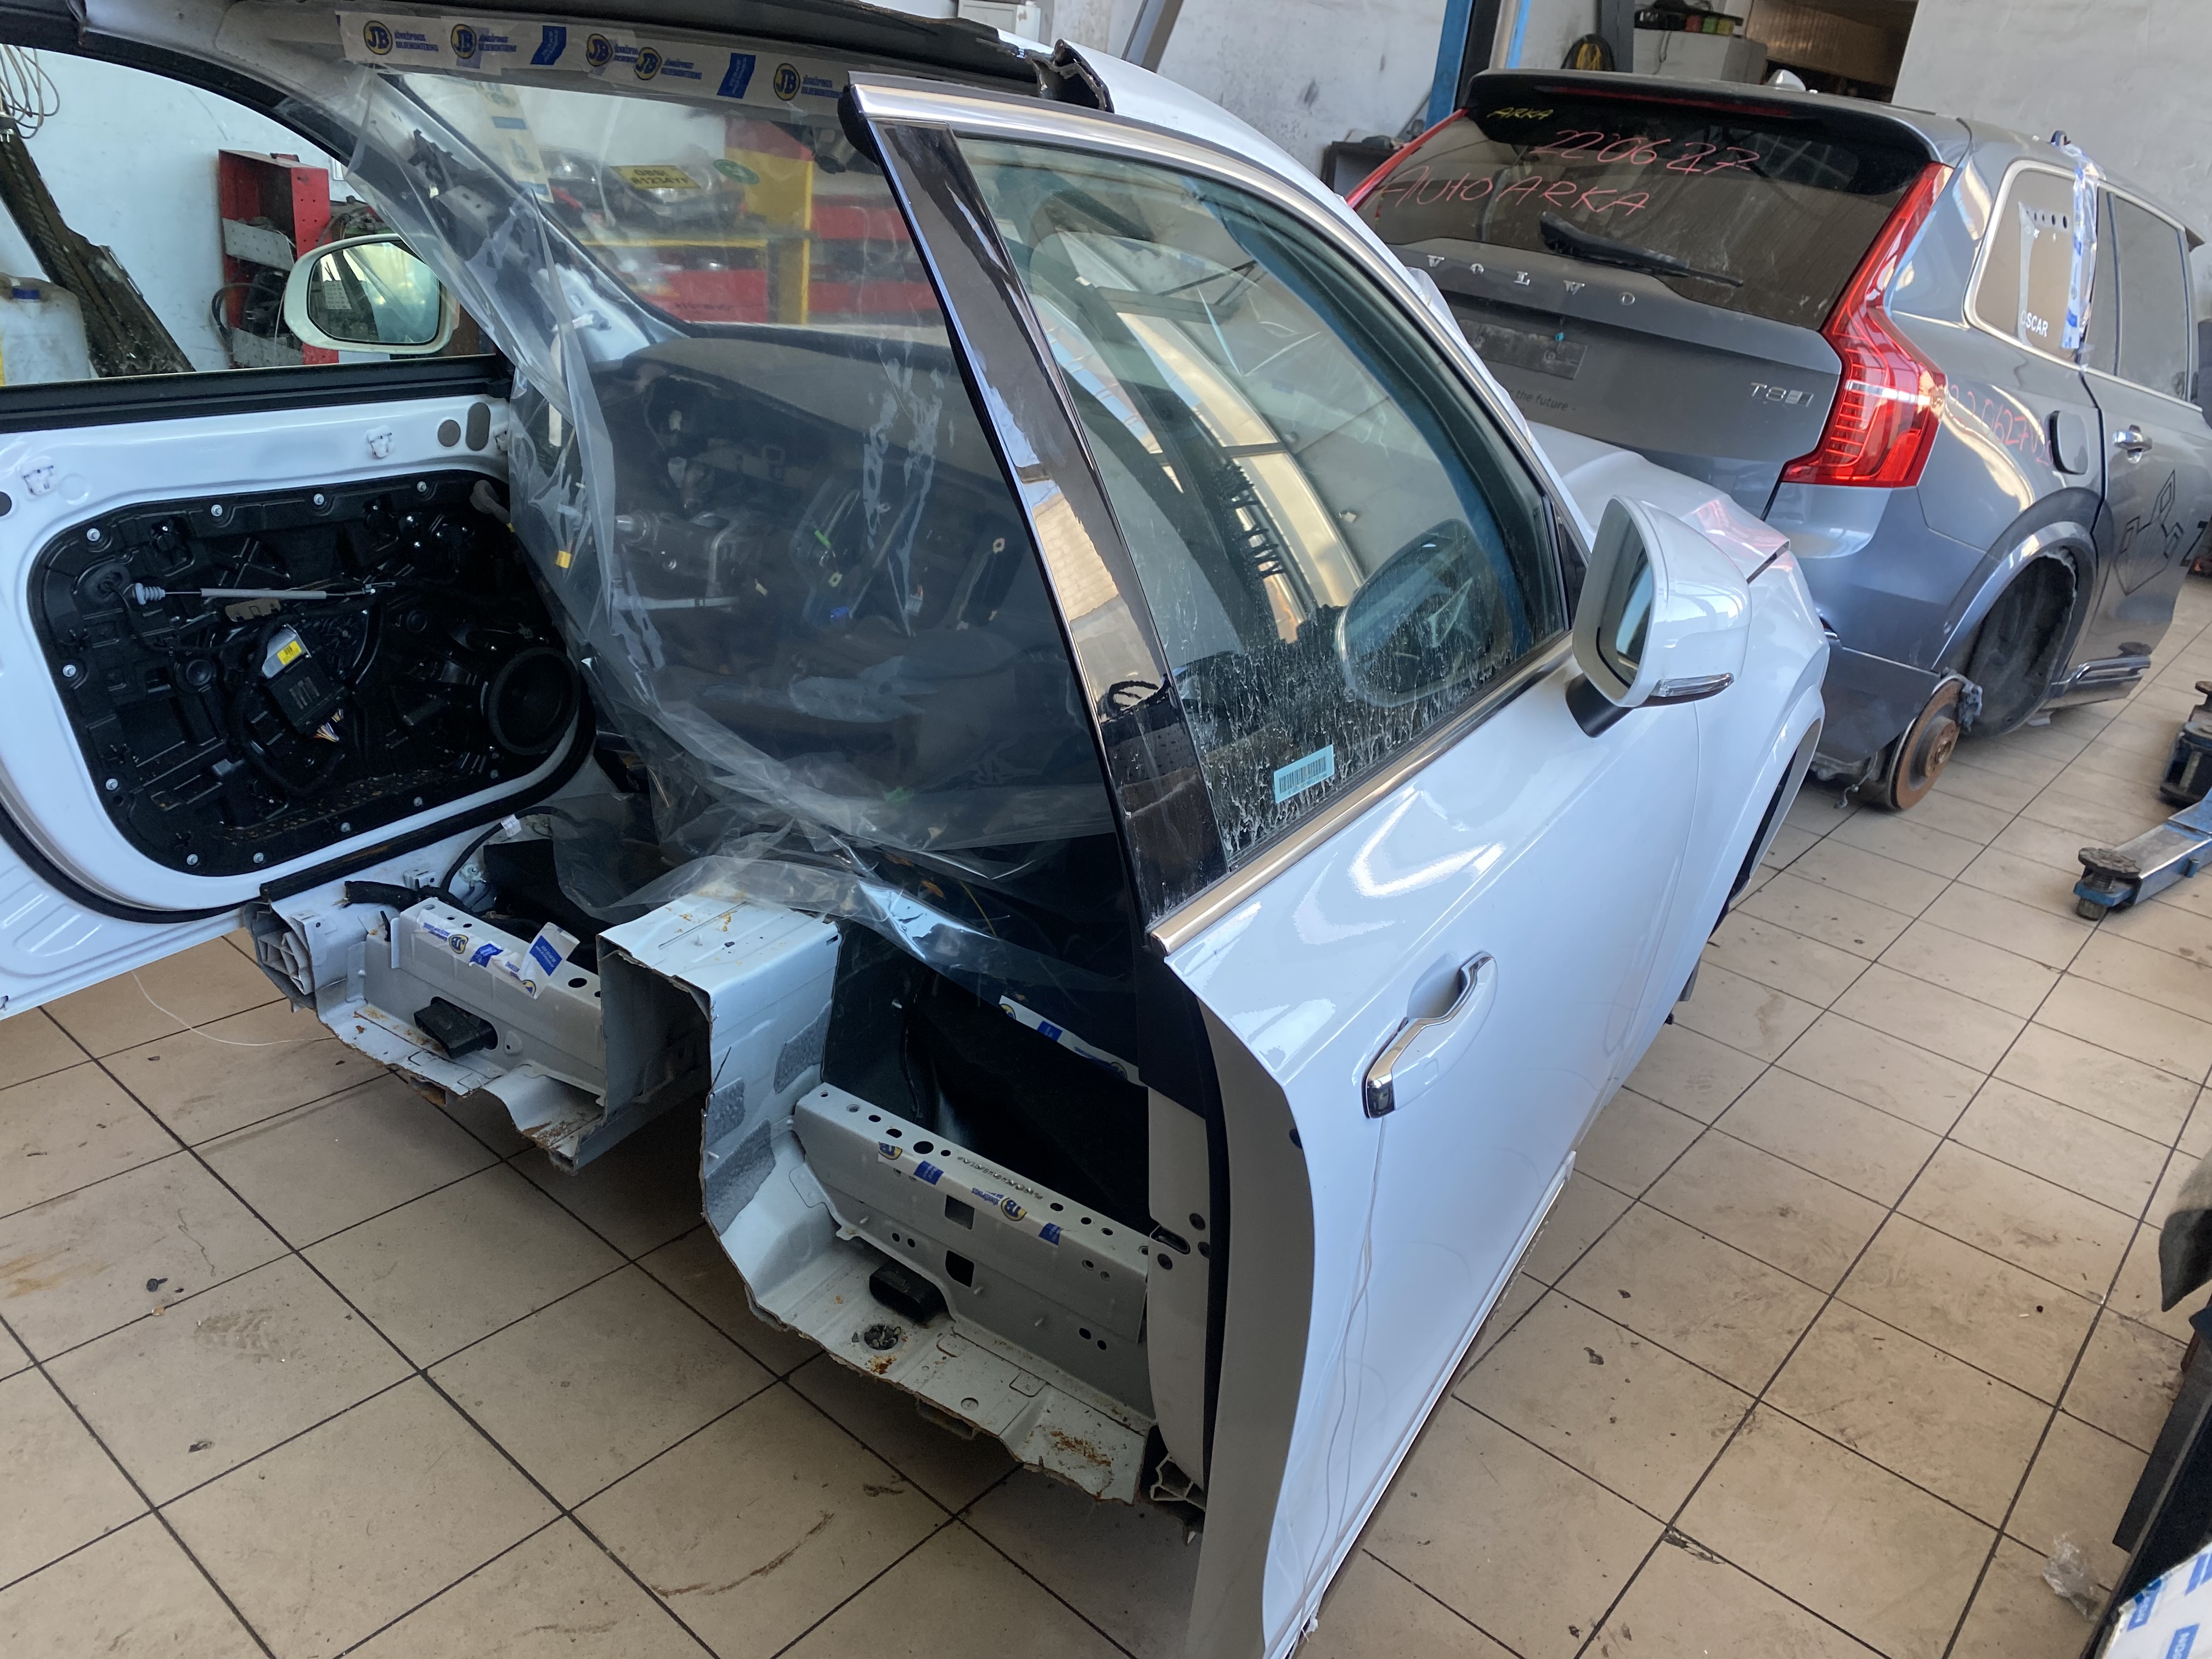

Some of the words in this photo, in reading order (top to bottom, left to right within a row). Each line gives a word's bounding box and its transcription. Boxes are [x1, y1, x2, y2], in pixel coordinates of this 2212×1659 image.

[367, 26, 390, 49] JB
[454, 29, 473, 53] JB
[589, 38, 610, 61] JB
[635, 53, 657, 74] JB
[775, 69, 797, 94] JB
[1495, 176, 1650, 216] ARKA
[1427, 255, 1636, 306] VOLVO
[1515, 390, 1533, 403] the
[1536, 394, 1569, 411] future
[1750, 382, 1787, 402] T8
